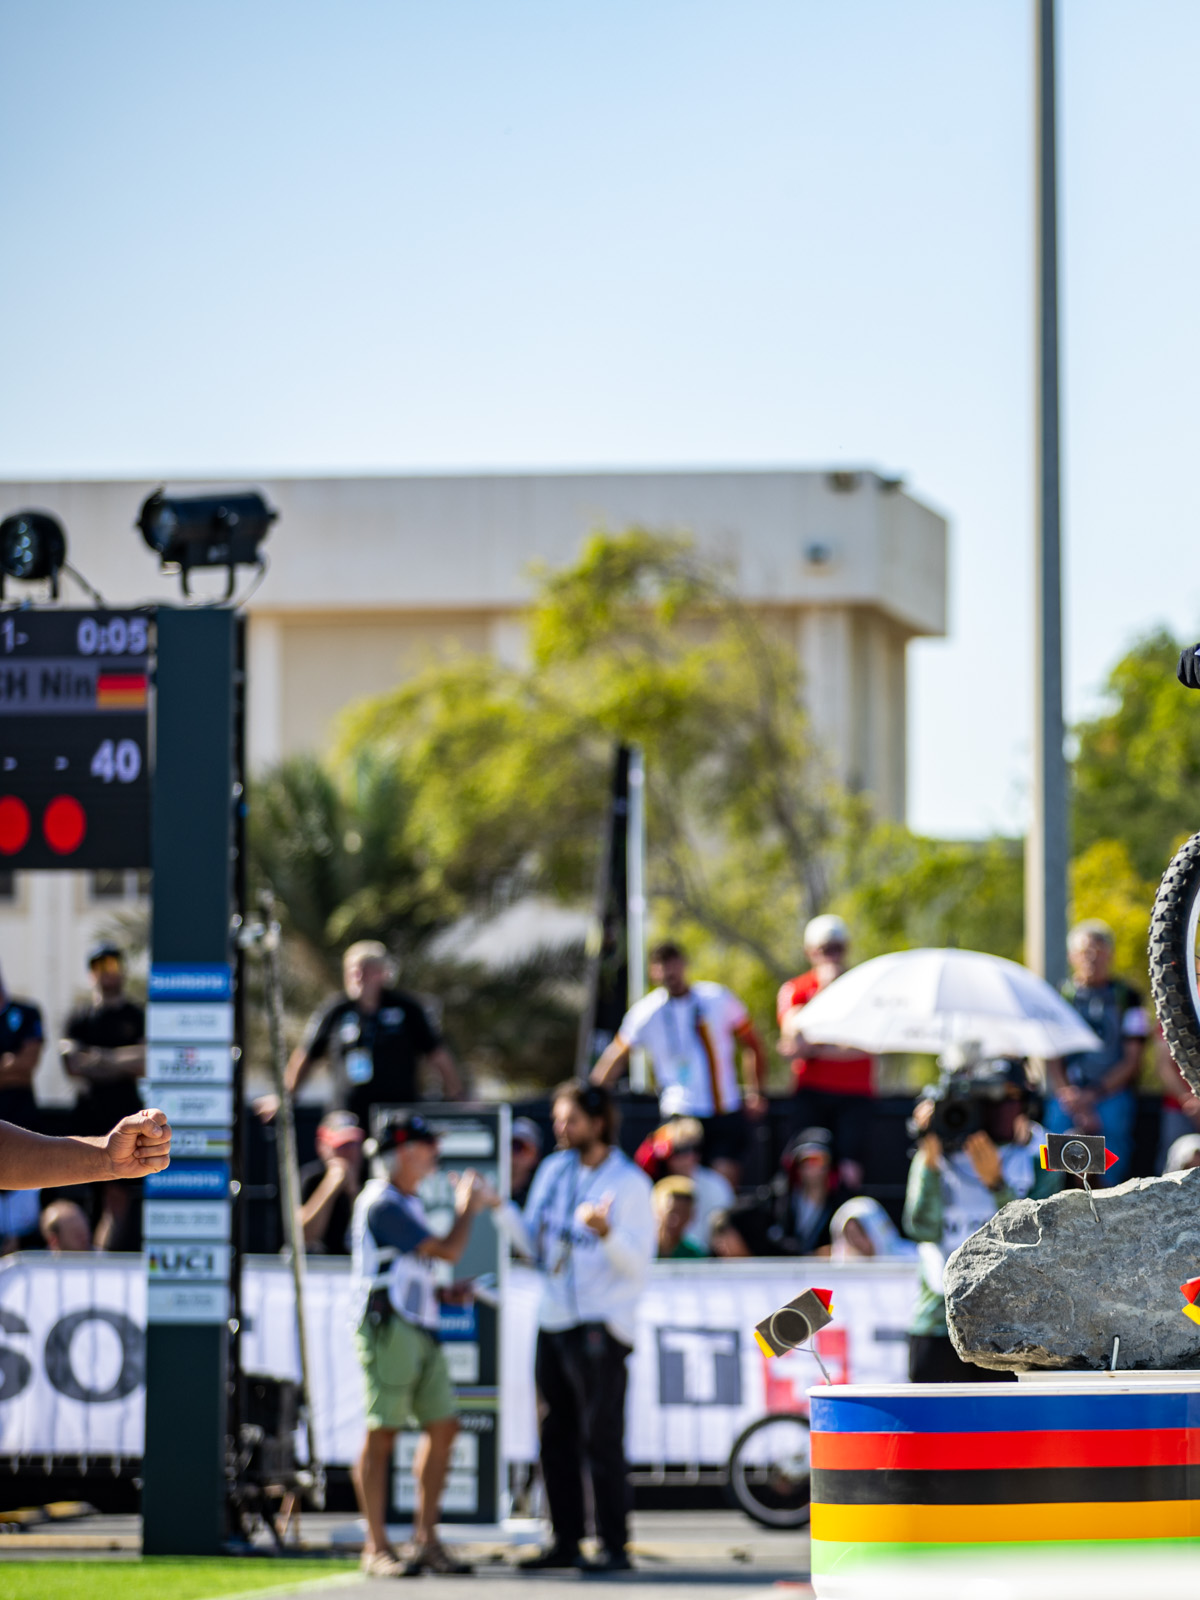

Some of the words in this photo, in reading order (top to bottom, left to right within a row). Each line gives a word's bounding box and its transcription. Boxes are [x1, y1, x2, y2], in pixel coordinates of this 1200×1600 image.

[77, 616, 148, 655] 0:05
[90, 738, 142, 784] 40
[162, 1251, 214, 1272] UCI
